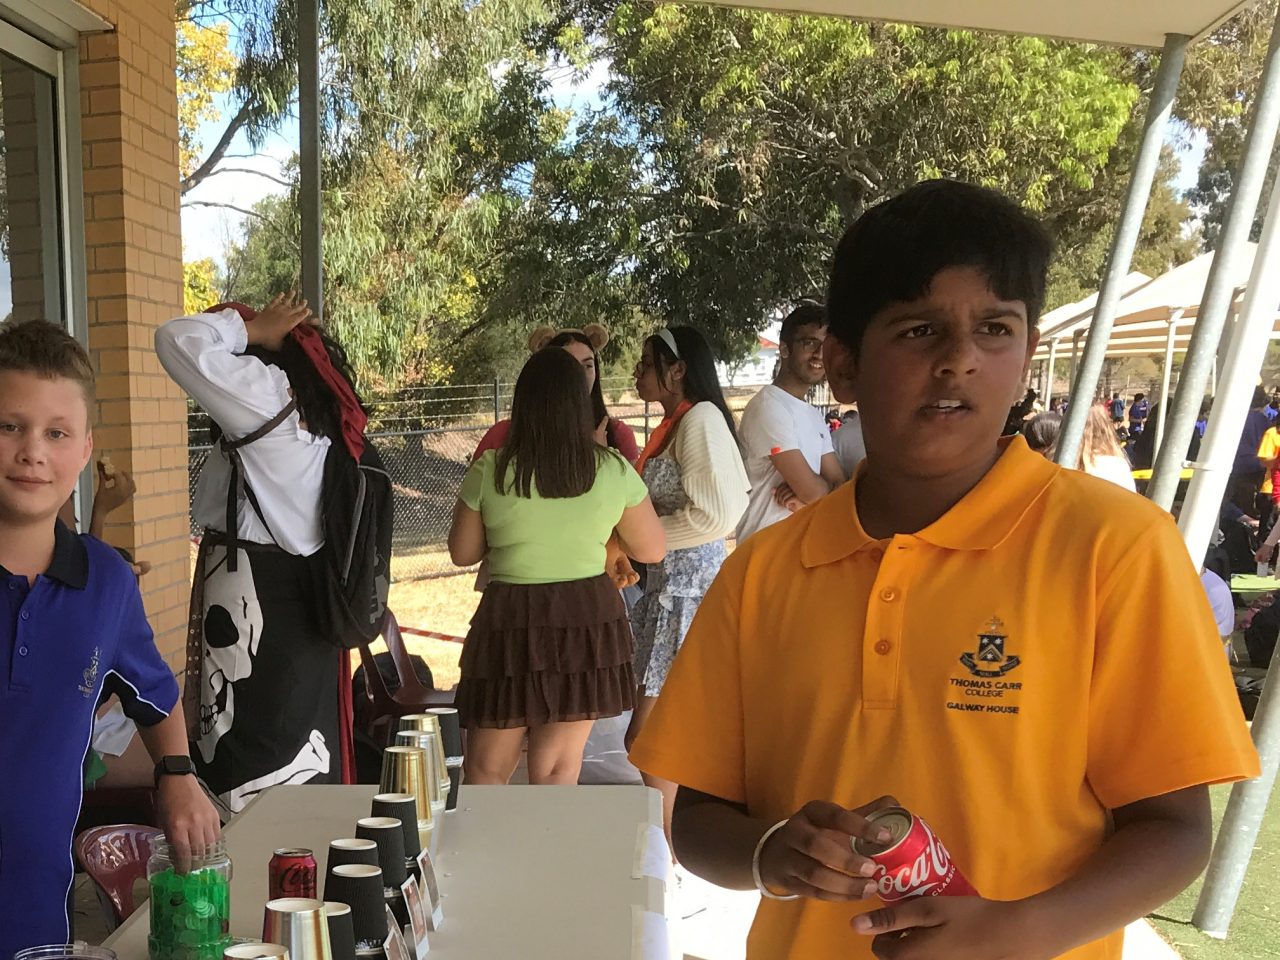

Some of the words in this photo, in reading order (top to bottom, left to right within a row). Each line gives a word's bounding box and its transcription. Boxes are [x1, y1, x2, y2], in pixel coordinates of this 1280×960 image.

[950, 678, 992, 688] THOMAS
[995, 682, 1022, 690] CARR
[965, 689, 1004, 697] COLLEGE
[947, 702, 985, 712] GALWAY
[987, 705, 1020, 714] HOUSE
[932, 865, 956, 897] CLASSIC
